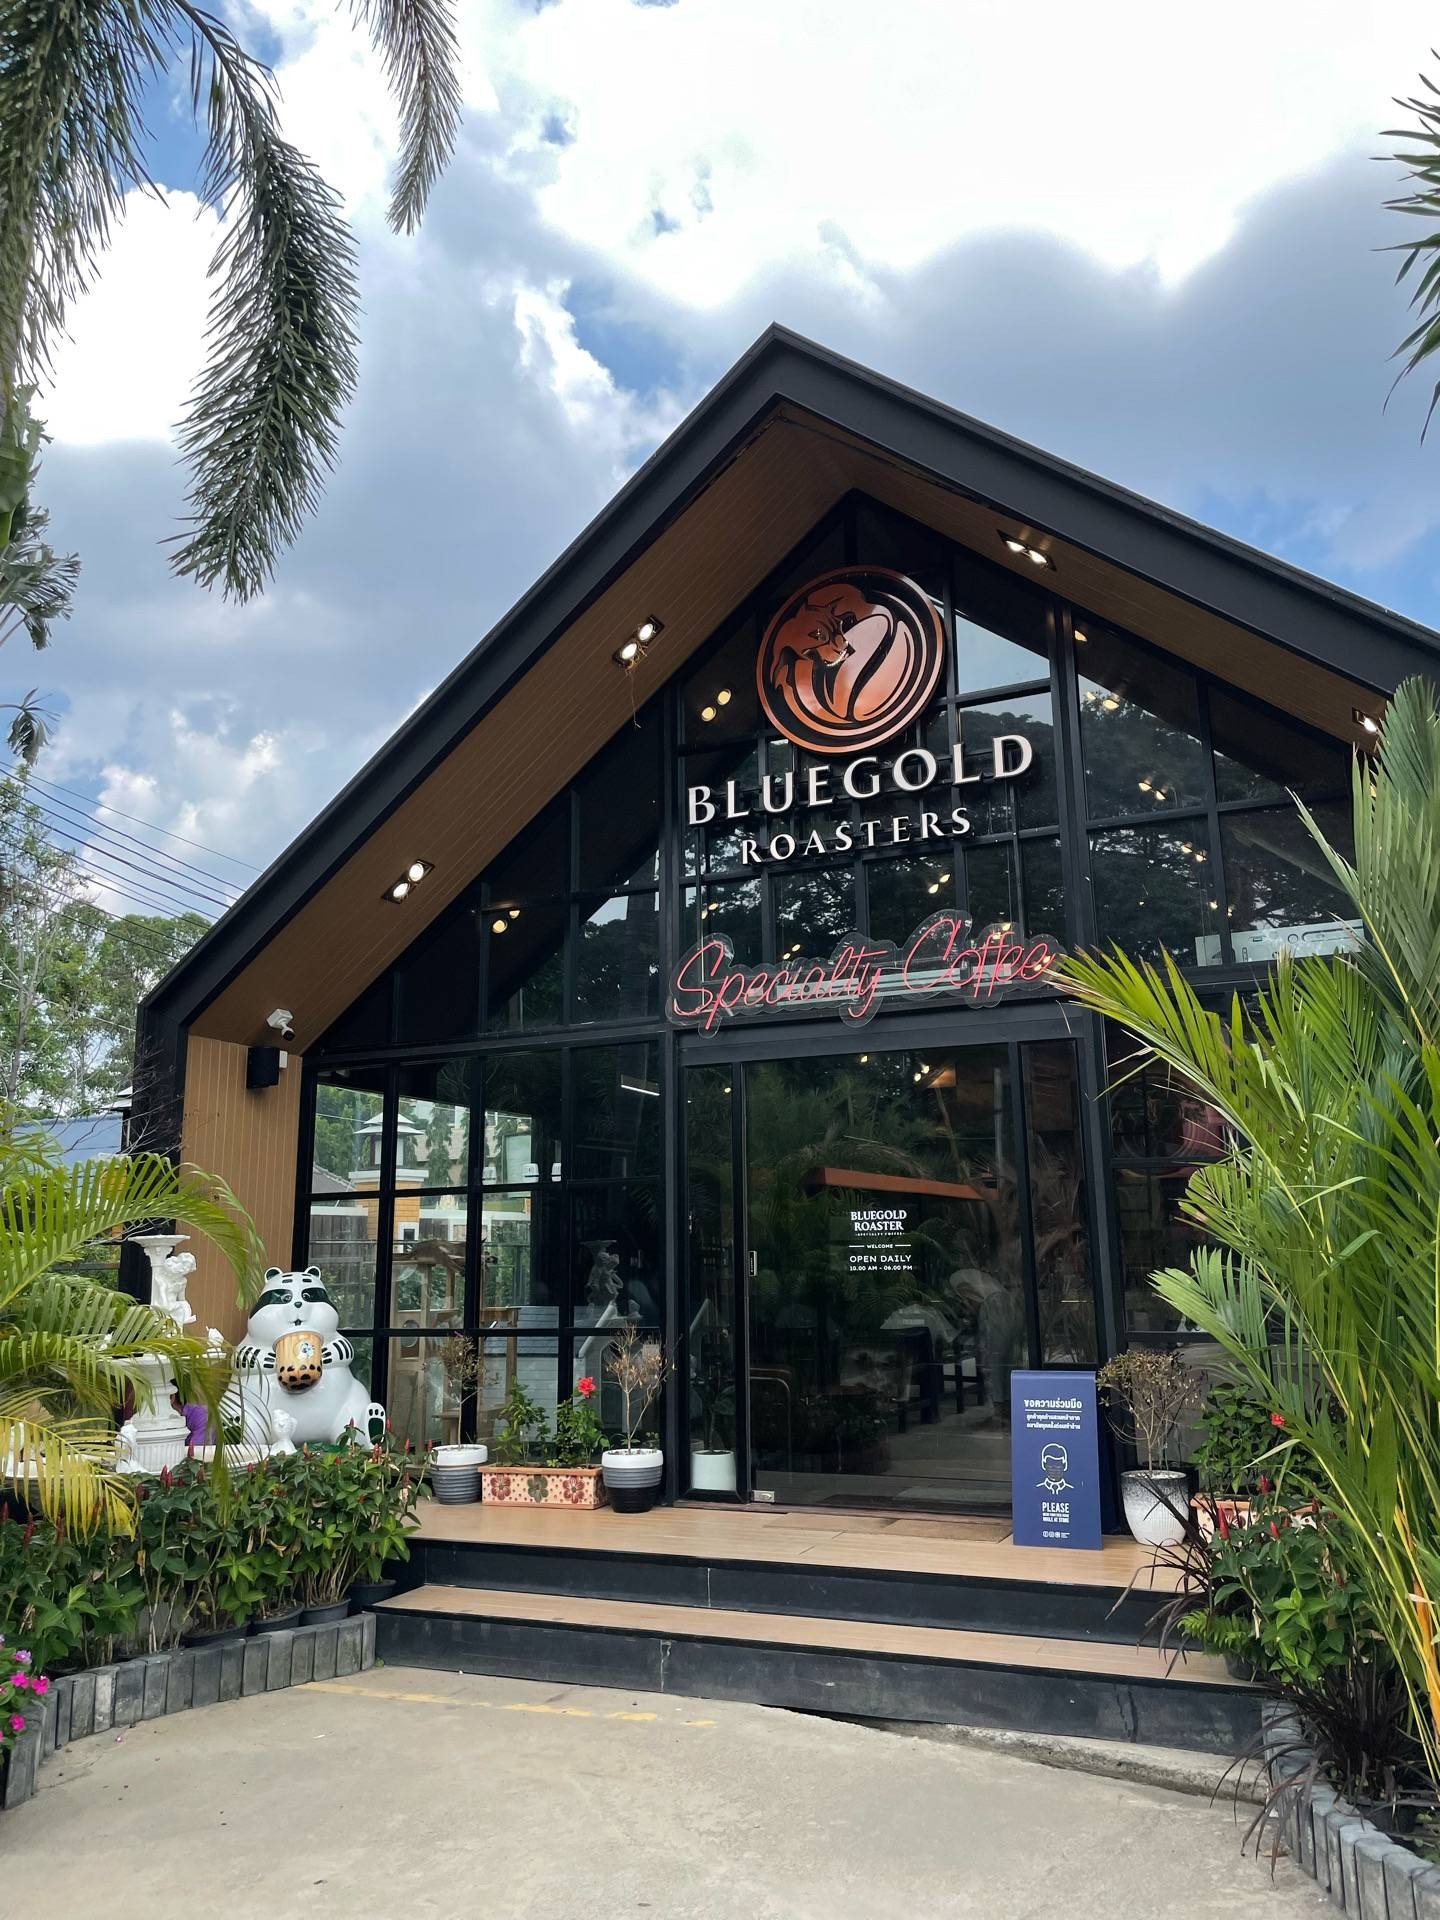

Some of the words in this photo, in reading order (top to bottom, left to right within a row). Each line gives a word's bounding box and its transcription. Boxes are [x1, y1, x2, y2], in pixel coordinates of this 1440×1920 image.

[687, 733, 1034, 826] BLUEGOLD
[740, 806, 972, 865] ROASTERS
[674, 940, 889, 1030] Specialty
[903, 918, 1056, 998] Coffee
[850, 1209, 907, 1221] BLUEGOLD
[854, 1220, 904, 1231] ROASTER
[849, 1255, 877, 1263] OPEN
[880, 1254, 912, 1263] DAILY
[1023, 1397, 1083, 1409] ขอความร่วมมือ
[1042, 1501, 1070, 1513] PLEASE
